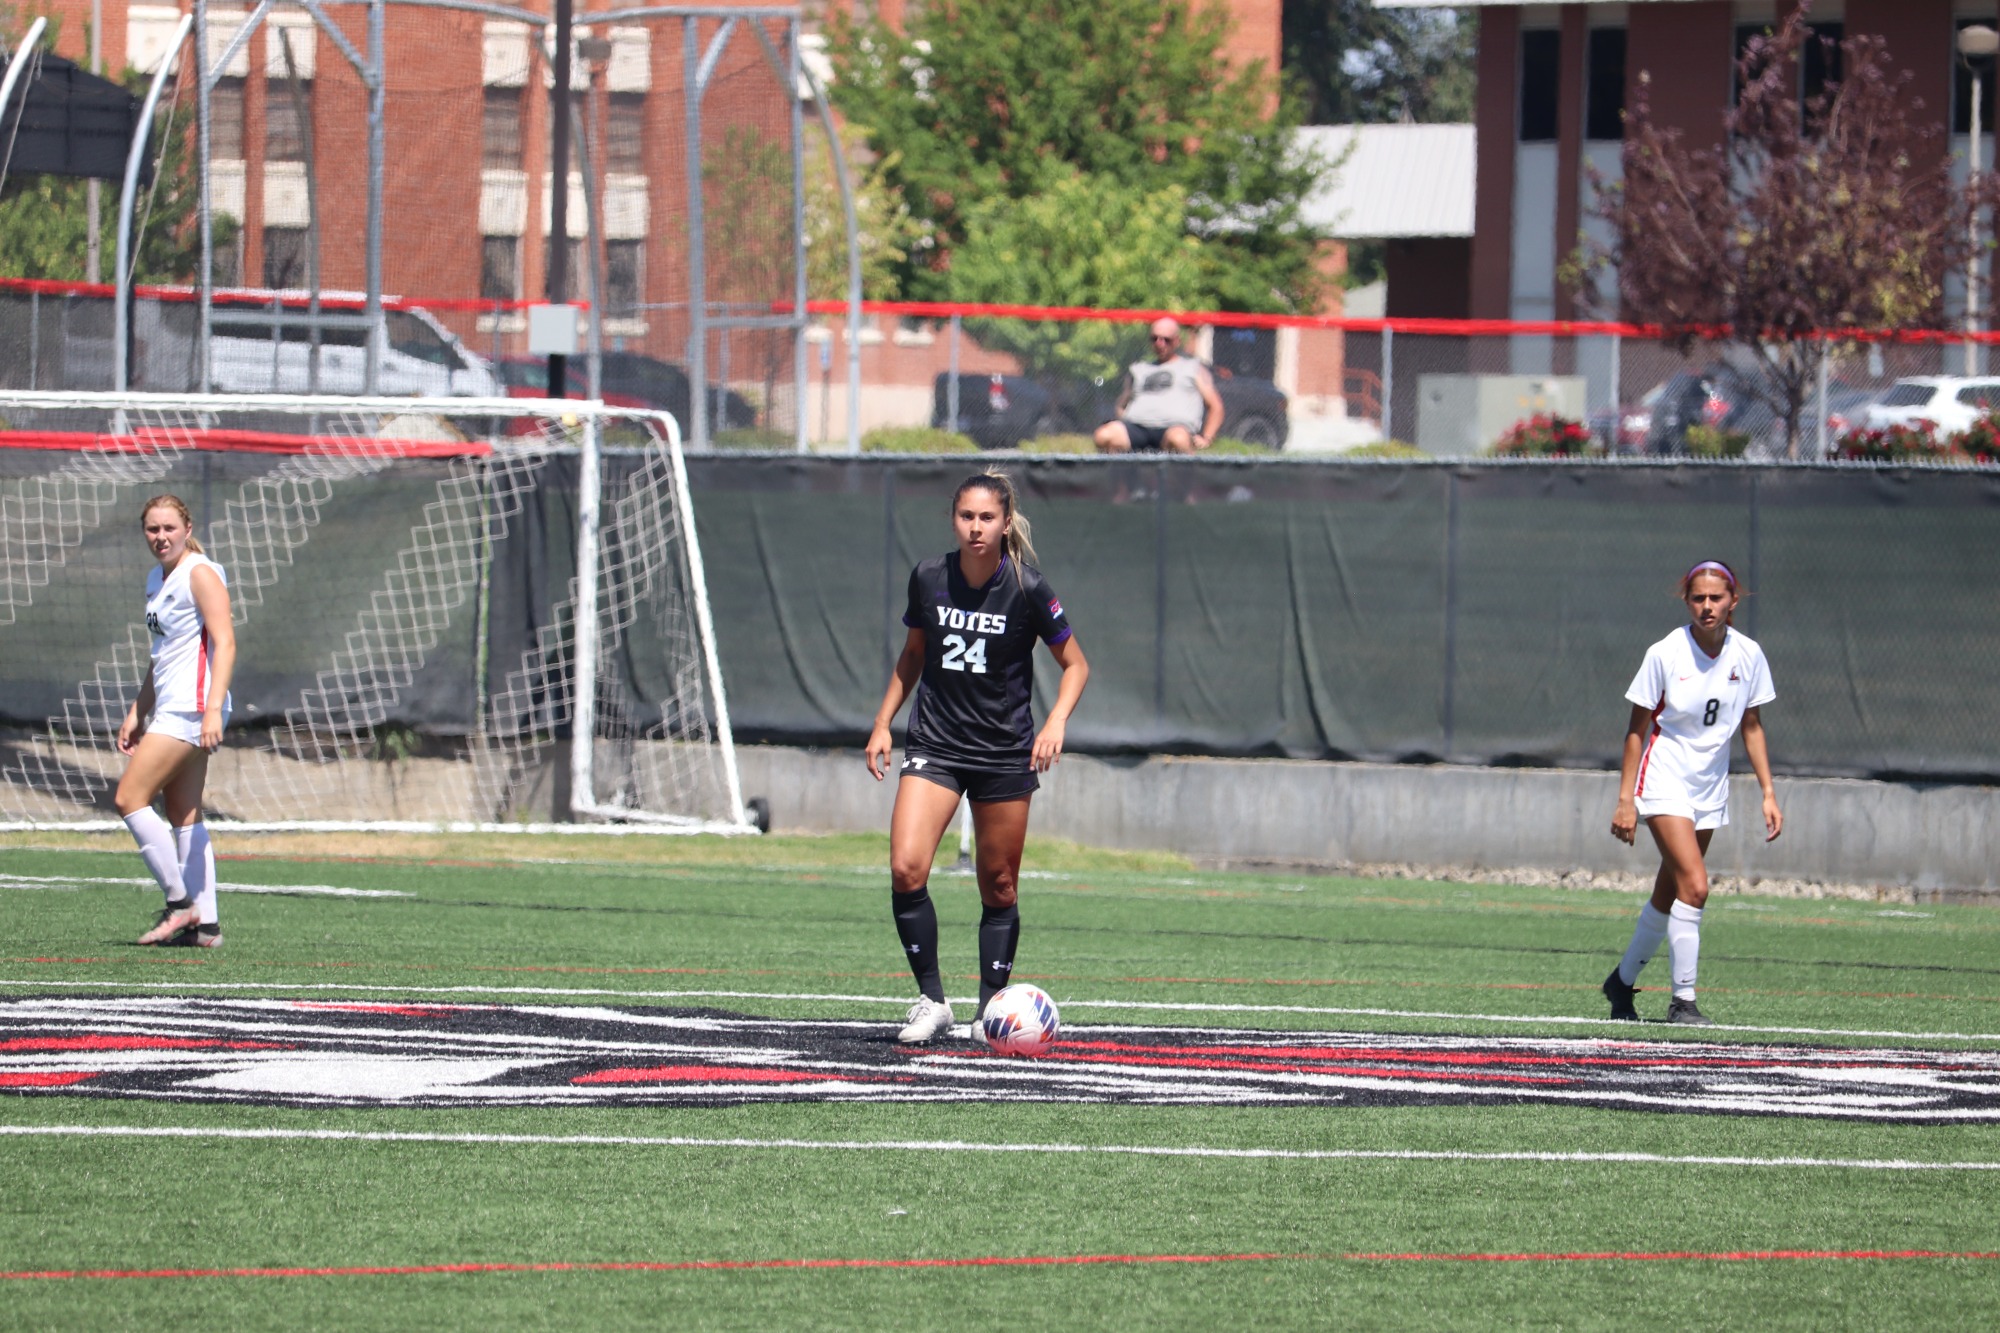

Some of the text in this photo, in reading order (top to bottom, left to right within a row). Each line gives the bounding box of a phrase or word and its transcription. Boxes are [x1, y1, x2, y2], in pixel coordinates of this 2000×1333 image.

[937, 606, 1006, 634] YOTES
[942, 634, 987, 673] 24
[1703, 698, 1720, 727] 8
